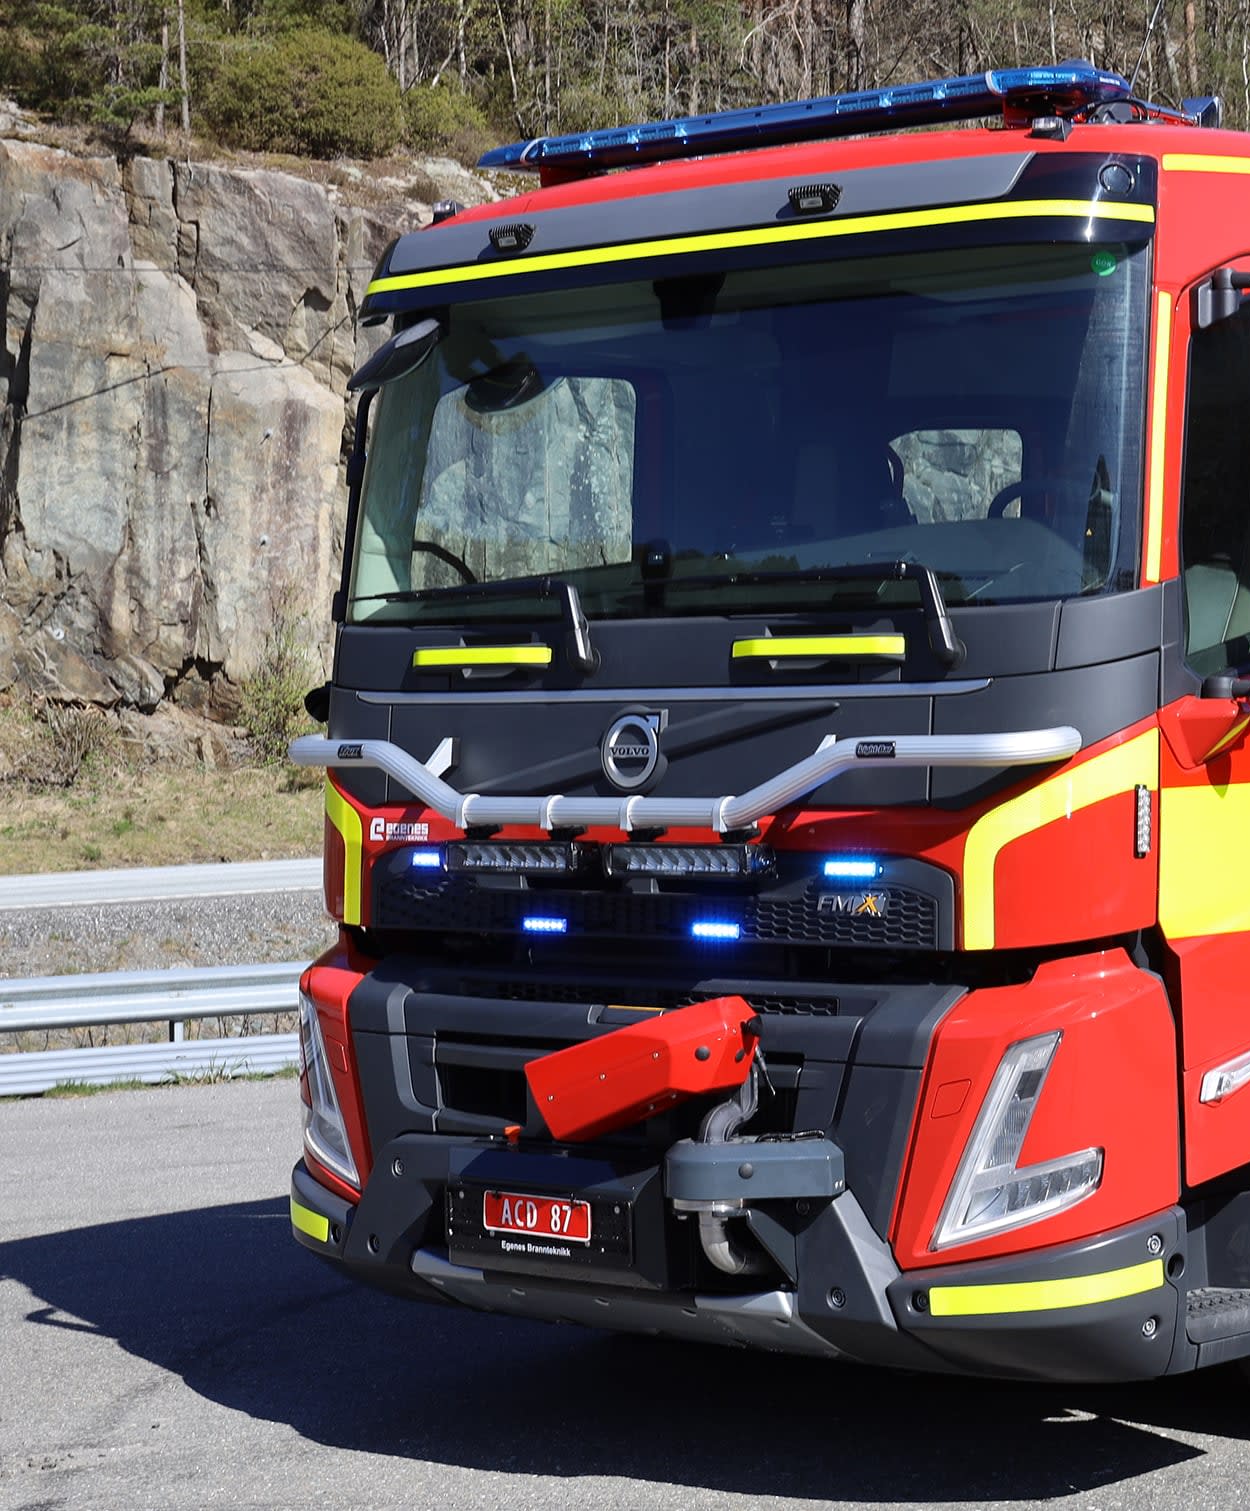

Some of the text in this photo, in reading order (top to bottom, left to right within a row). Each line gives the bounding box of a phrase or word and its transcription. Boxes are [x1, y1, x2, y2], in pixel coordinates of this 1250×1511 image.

[610, 746, 650, 756] VOLVO
[817, 894, 884, 916] FMX
[502, 1199, 572, 1232] ACD 87
[501, 1240, 571, 1257] Egenes Brannteknikk
